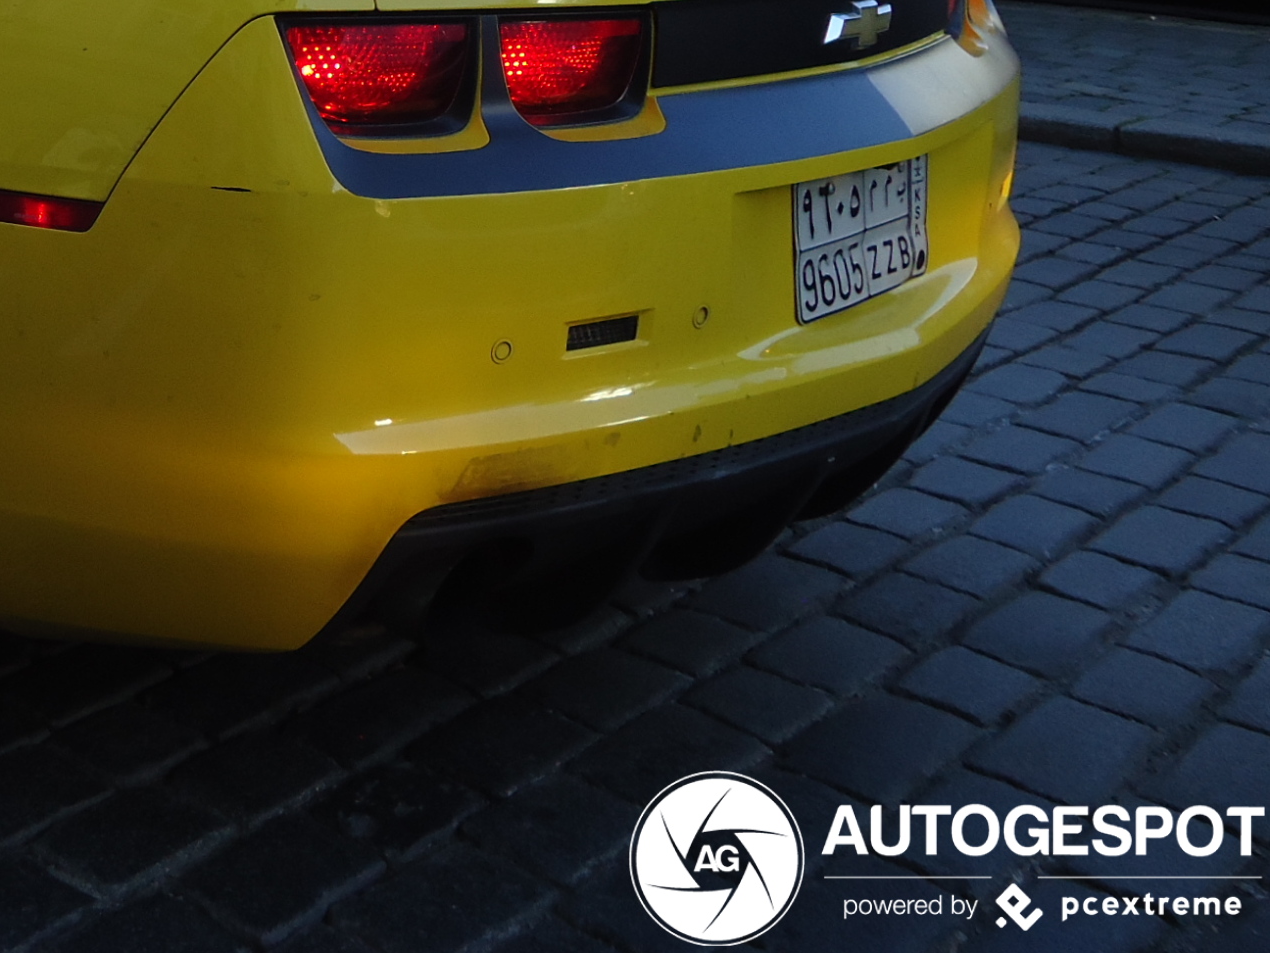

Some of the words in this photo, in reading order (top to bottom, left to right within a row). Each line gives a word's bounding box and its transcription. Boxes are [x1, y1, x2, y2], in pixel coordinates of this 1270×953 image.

[914, 188, 922, 238] KSA
[802, 242, 864, 312] 9605
[867, 235, 911, 280] ZZB
